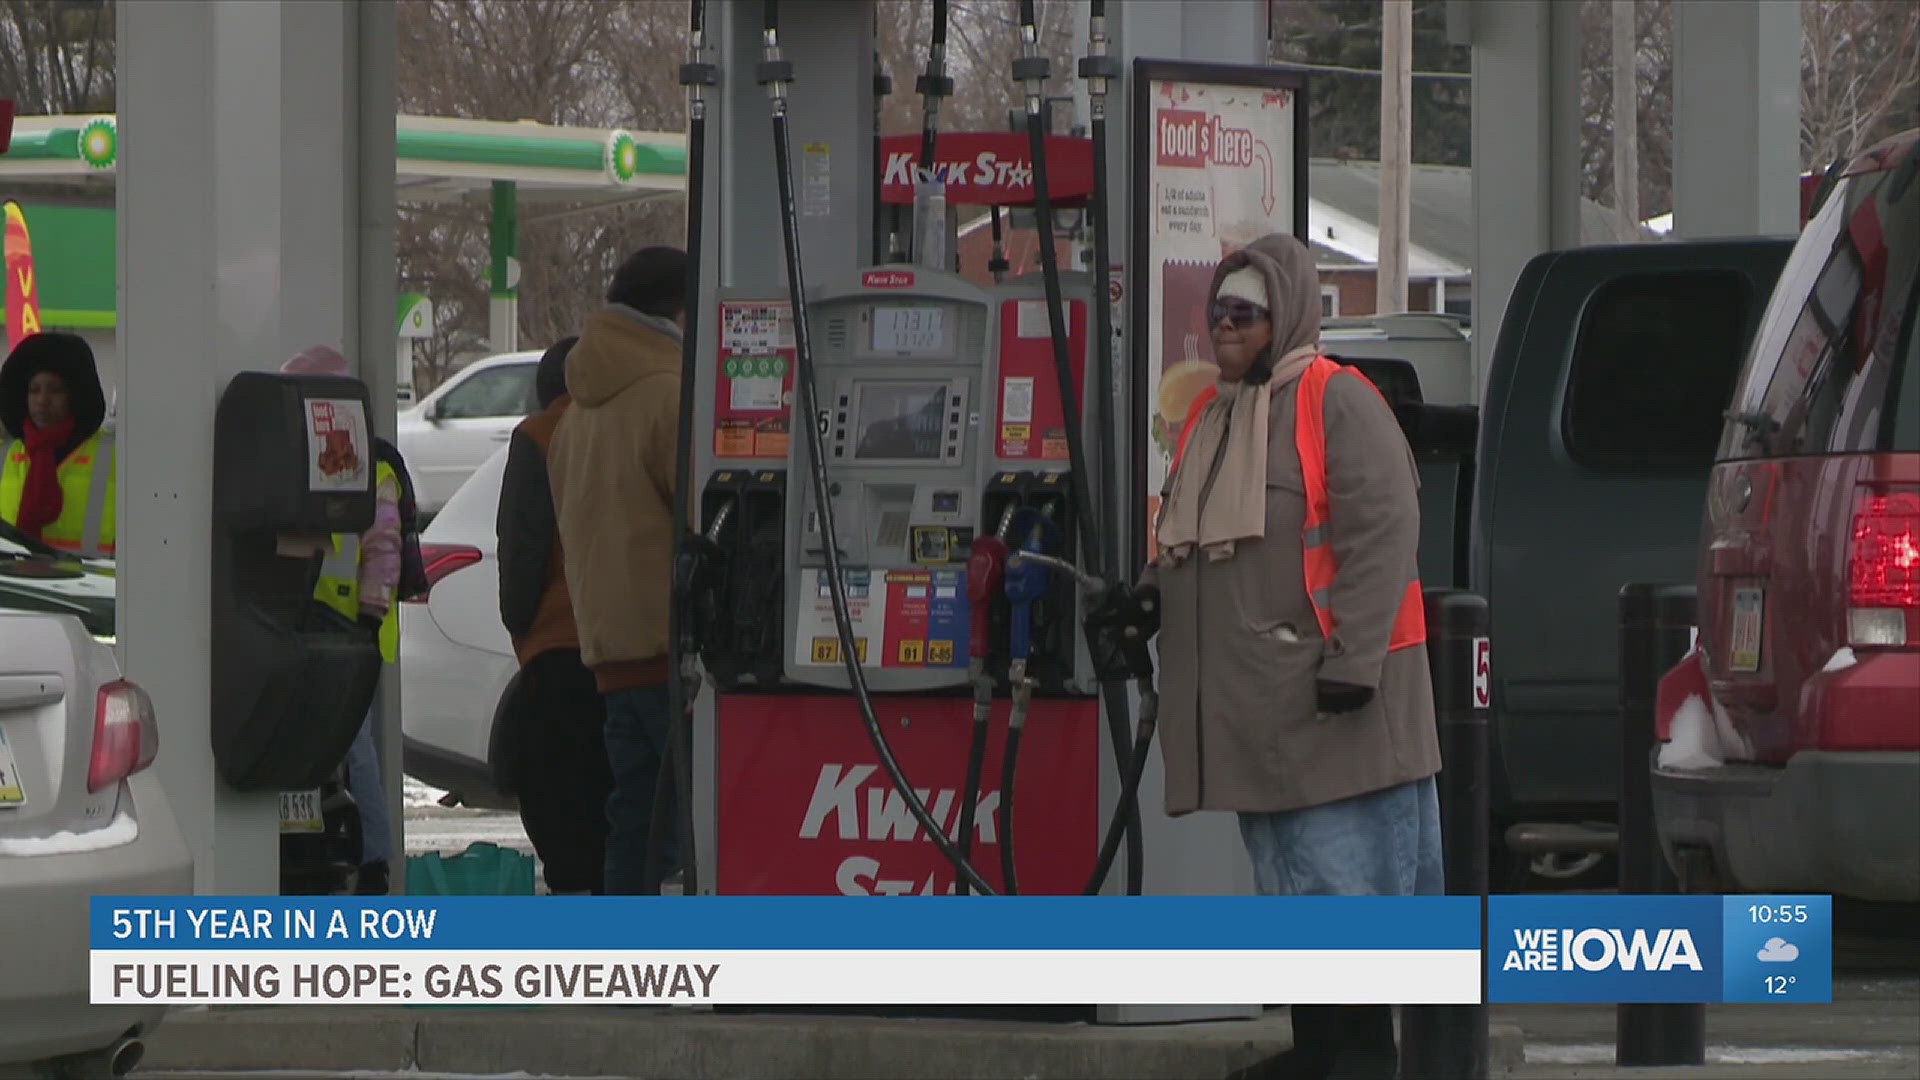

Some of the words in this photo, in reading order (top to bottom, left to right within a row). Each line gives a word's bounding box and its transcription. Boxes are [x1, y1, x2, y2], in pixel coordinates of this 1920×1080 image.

[1214, 117, 1251, 165] here
[1476, 640, 1490, 705] 5
[799, 763, 1001, 843] KWIK
